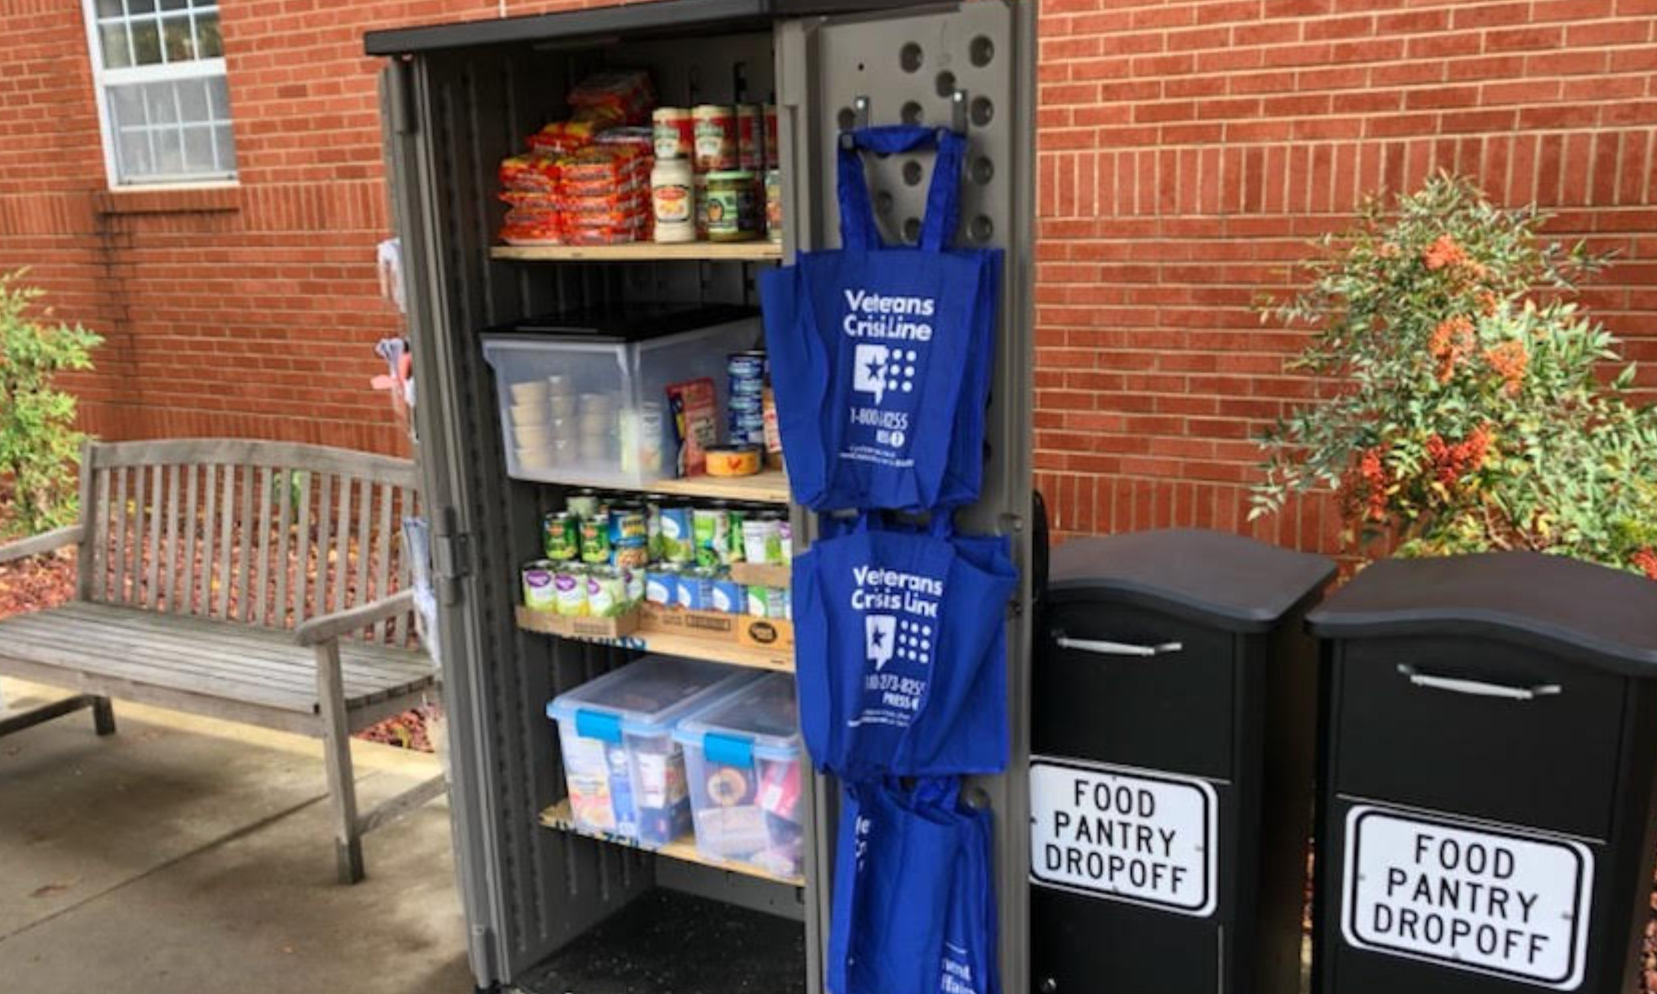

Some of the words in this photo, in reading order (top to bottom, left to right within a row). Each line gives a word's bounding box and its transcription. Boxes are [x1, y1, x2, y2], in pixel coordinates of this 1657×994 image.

[844, 289, 934, 316] Veteans
[843, 314, 886, 338] Crisi
[887, 315, 932, 341] Line
[851, 588, 901, 611] Crisis
[853, 565, 943, 596] Veterans
[1074, 778, 1156, 819] FOOD
[1054, 810, 1176, 858] PANTRY
[1045, 843, 1188, 895] DROPOFF
[1414, 833, 1516, 880] FOOD
[1386, 866, 1539, 925] PANTRY
[1373, 901, 1550, 965] DROPOFF
